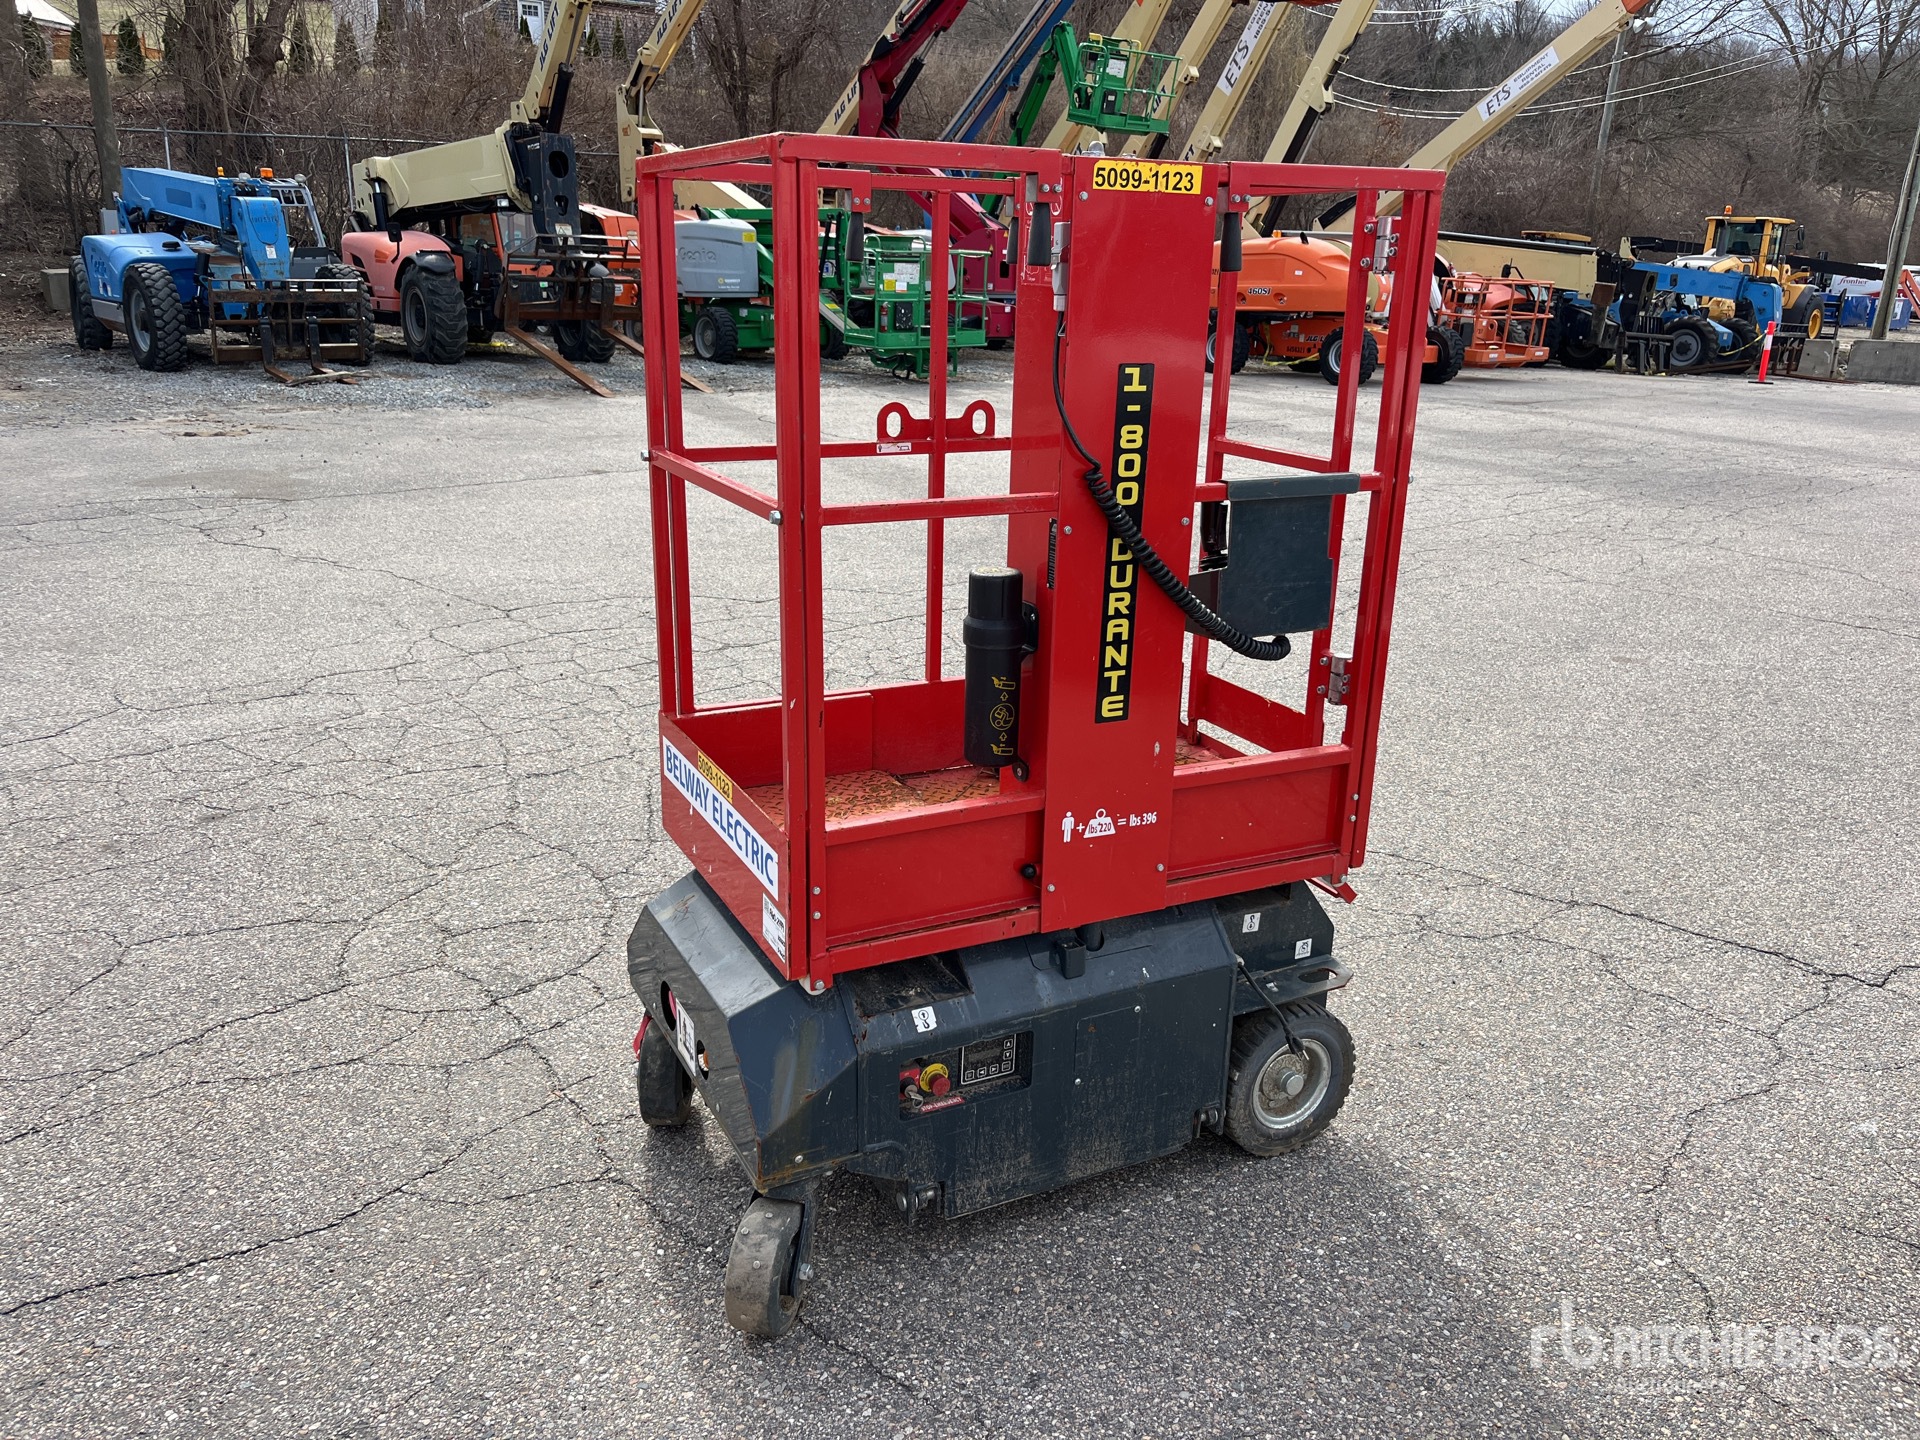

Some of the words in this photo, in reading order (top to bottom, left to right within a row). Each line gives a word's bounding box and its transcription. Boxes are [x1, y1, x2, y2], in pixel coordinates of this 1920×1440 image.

[539, 39, 549, 72] JLG
[547, 1, 560, 41] LIFT
[656, 22, 668, 45] JLG
[1224, 39, 1250, 89] ETS
[1513, 51, 1549, 83] EQUIPMENT
[1521, 63, 1546, 83] RENTAL
[834, 103, 846, 125] JLG
[847, 80, 859, 105] LIF
[1485, 84, 1511, 116] ETS
[1094, 166, 1195, 192] 5099-1123
[1247, 286, 1272, 296] 460SJ
[1837, 276, 1869, 286] frontier
[1305, 334, 1319, 342] JLG
[1100, 537, 1134, 719] DURANTE
[697, 754, 731, 799] 5099-1123
[665, 743, 710, 814] BELWAY
[712, 792, 774, 888] ELECTRIC
[1087, 823, 1098, 835] lbs
[1098, 821, 1112, 833] 220
[1129, 813, 1141, 827] lbs
[1141, 811, 1158, 825] 396
